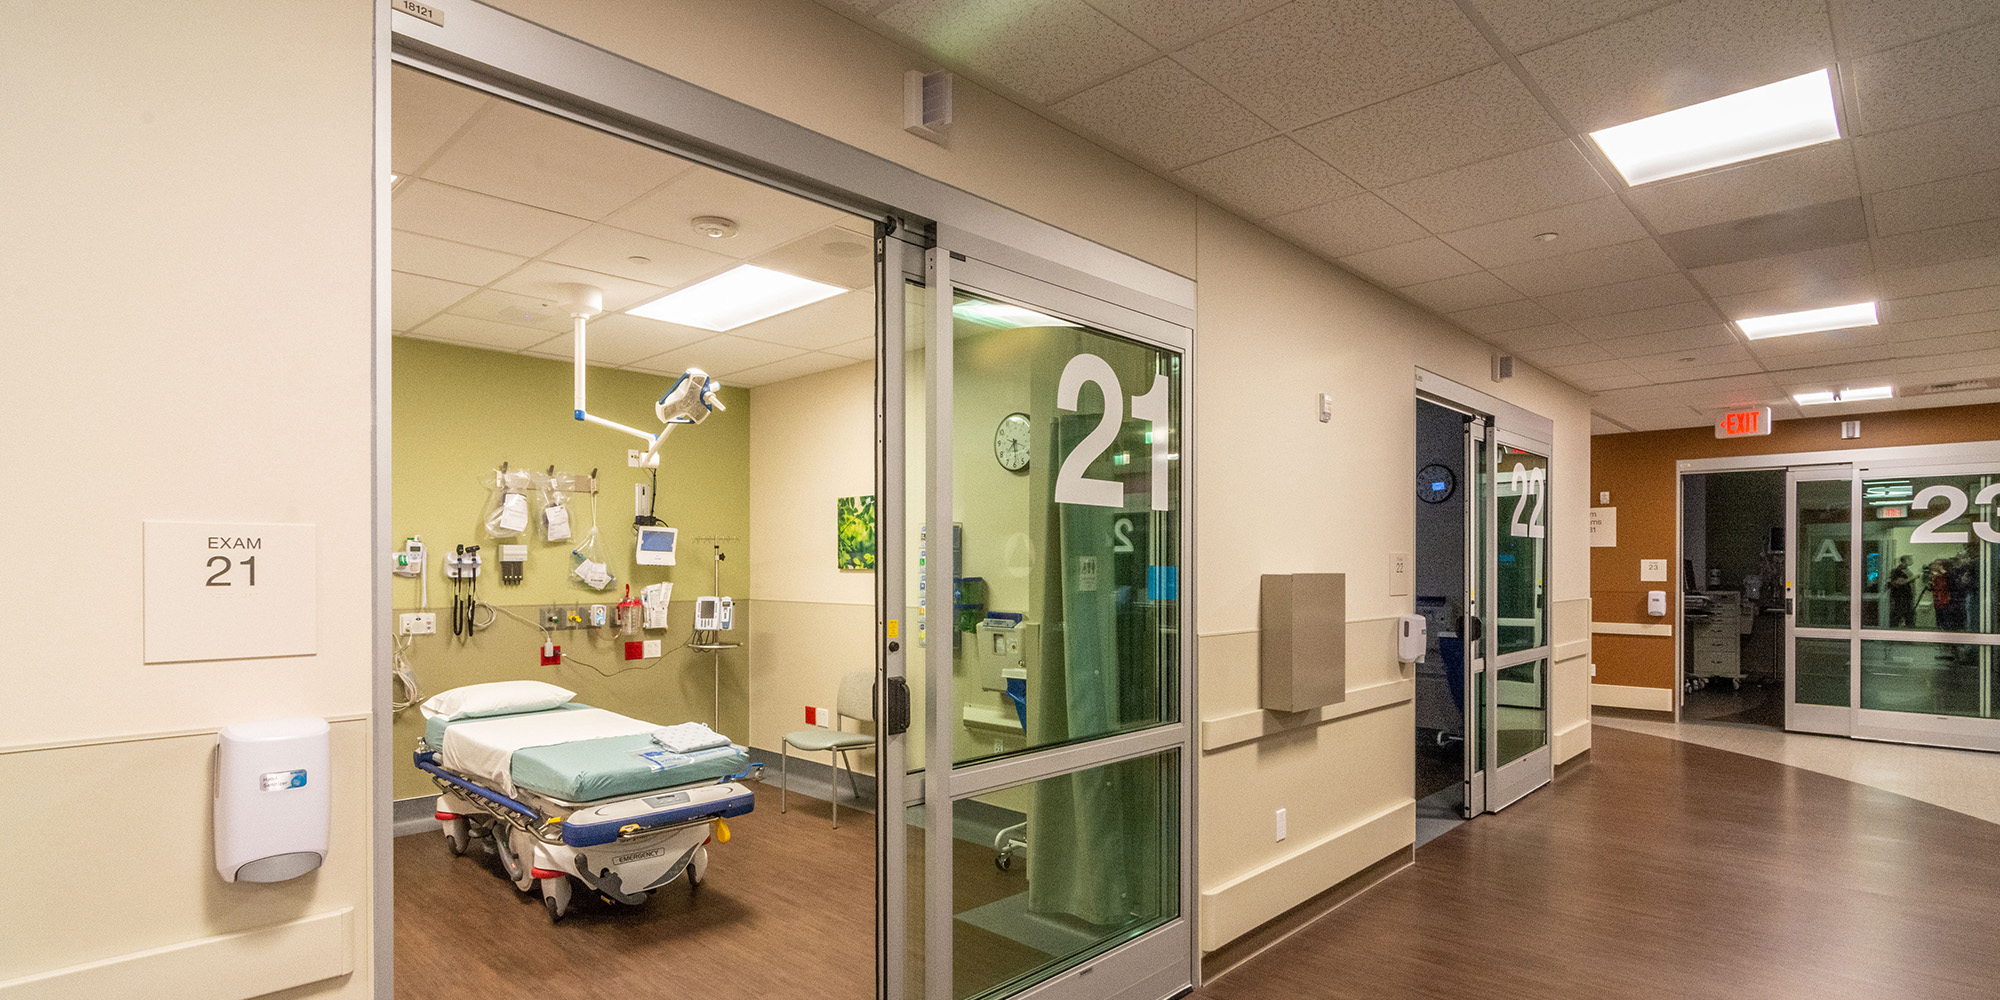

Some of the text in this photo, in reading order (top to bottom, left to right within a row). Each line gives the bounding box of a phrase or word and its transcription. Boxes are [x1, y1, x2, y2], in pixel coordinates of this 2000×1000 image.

[403, 0, 433, 18] 18121
[1055, 353, 1168, 511] 21
[1726, 411, 1760, 435] EXIT
[1511, 462, 1545, 539] 22
[208, 536, 262, 550] EXAM
[205, 555, 255, 587] 21
[618, 849, 660, 863] EMERGENCY
